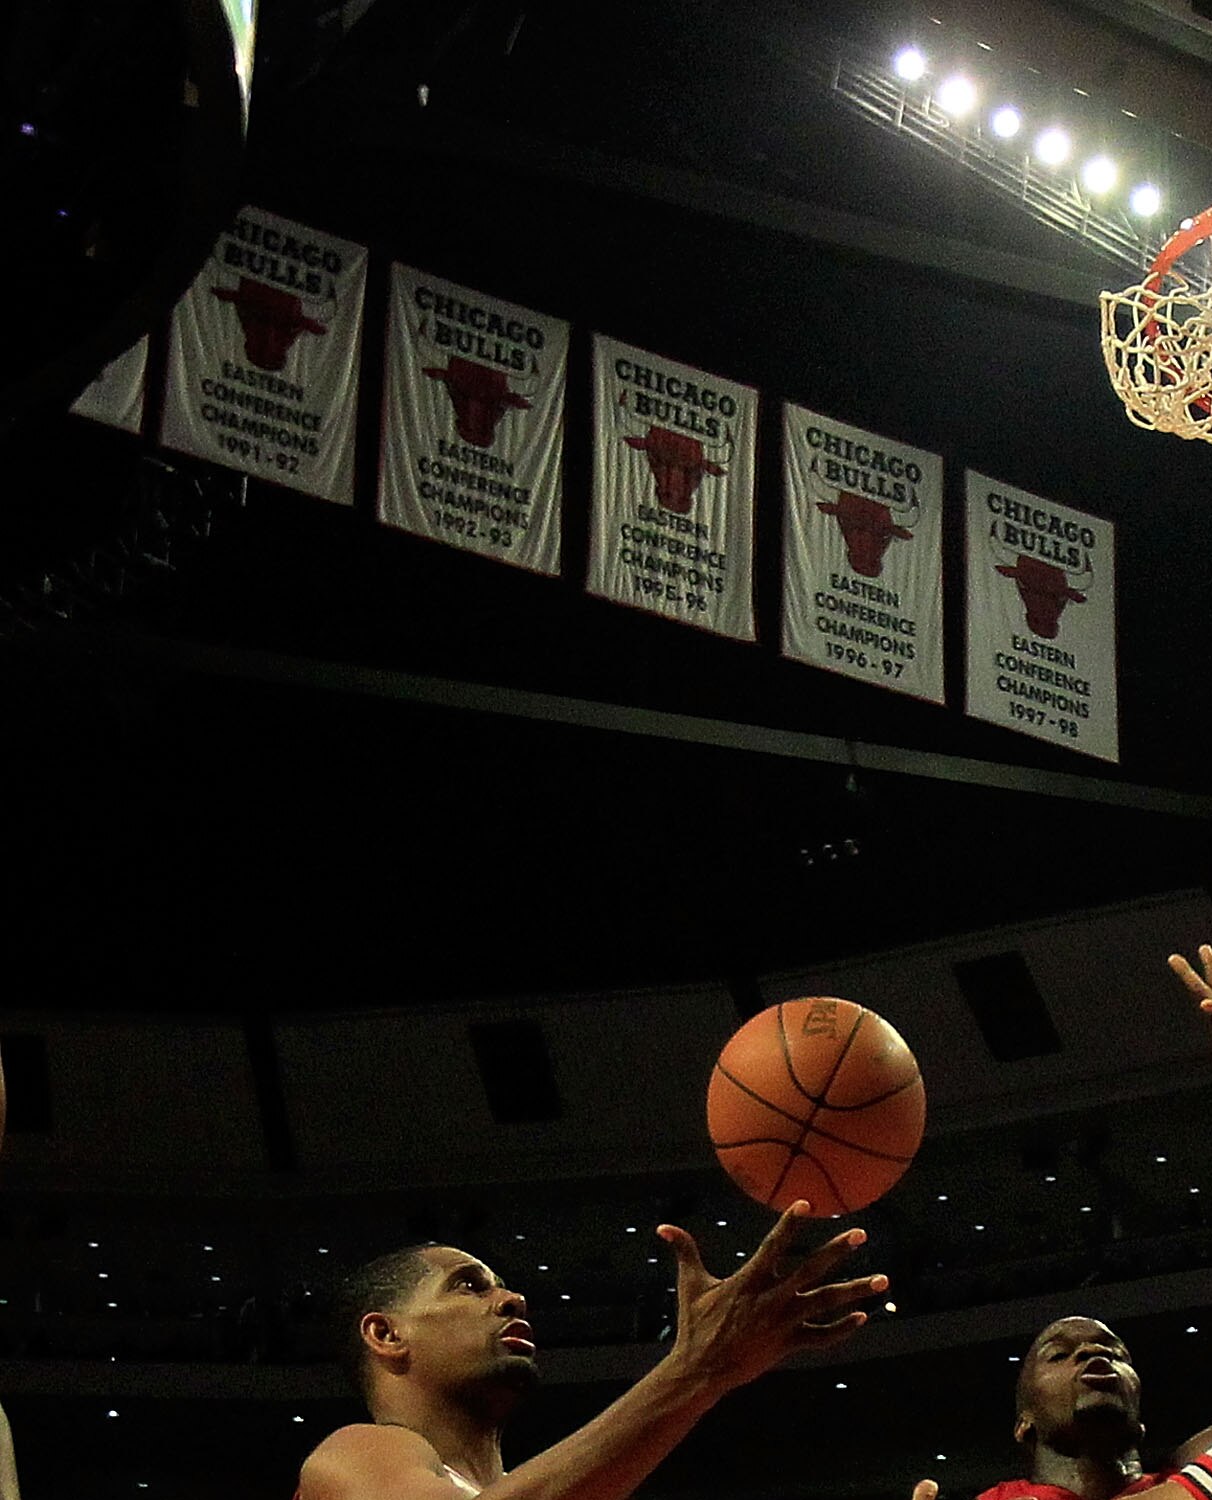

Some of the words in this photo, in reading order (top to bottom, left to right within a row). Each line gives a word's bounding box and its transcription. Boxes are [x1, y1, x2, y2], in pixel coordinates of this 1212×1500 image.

[225, 243, 321, 293] BULLS
[415, 286, 544, 349] CHICAGO
[436, 320, 525, 371] BULLS
[224, 362, 303, 401] EASTERN
[615, 359, 736, 416] CHICAGO
[202, 379, 321, 431] CONFERENCE
[635, 392, 719, 437] BULLS
[201, 404, 319, 455] CHAMPIONS
[439, 440, 514, 477] EASTERN
[806, 427, 921, 482] CHICAGO
[418, 457, 531, 504] CONFERENCE
[826, 459, 906, 502] BULLS
[420, 481, 529, 530] CHAMPIONS
[638, 505, 708, 540] EASTERN
[987, 493, 1095, 549] CHICAGO
[621, 524, 726, 570] CONFERENCE
[1004, 522, 1080, 568] BULLS
[621, 549, 723, 593] CHAMPIONS
[831, 574, 899, 609] EASTERN
[815, 592, 916, 637] CONFERENCE
[816, 617, 915, 660] CHAMPIONS
[1012, 635, 1075, 670] EASTERN
[995, 652, 1091, 697] CONFERENCE
[997, 676, 1089, 718] CHAMPIONS
